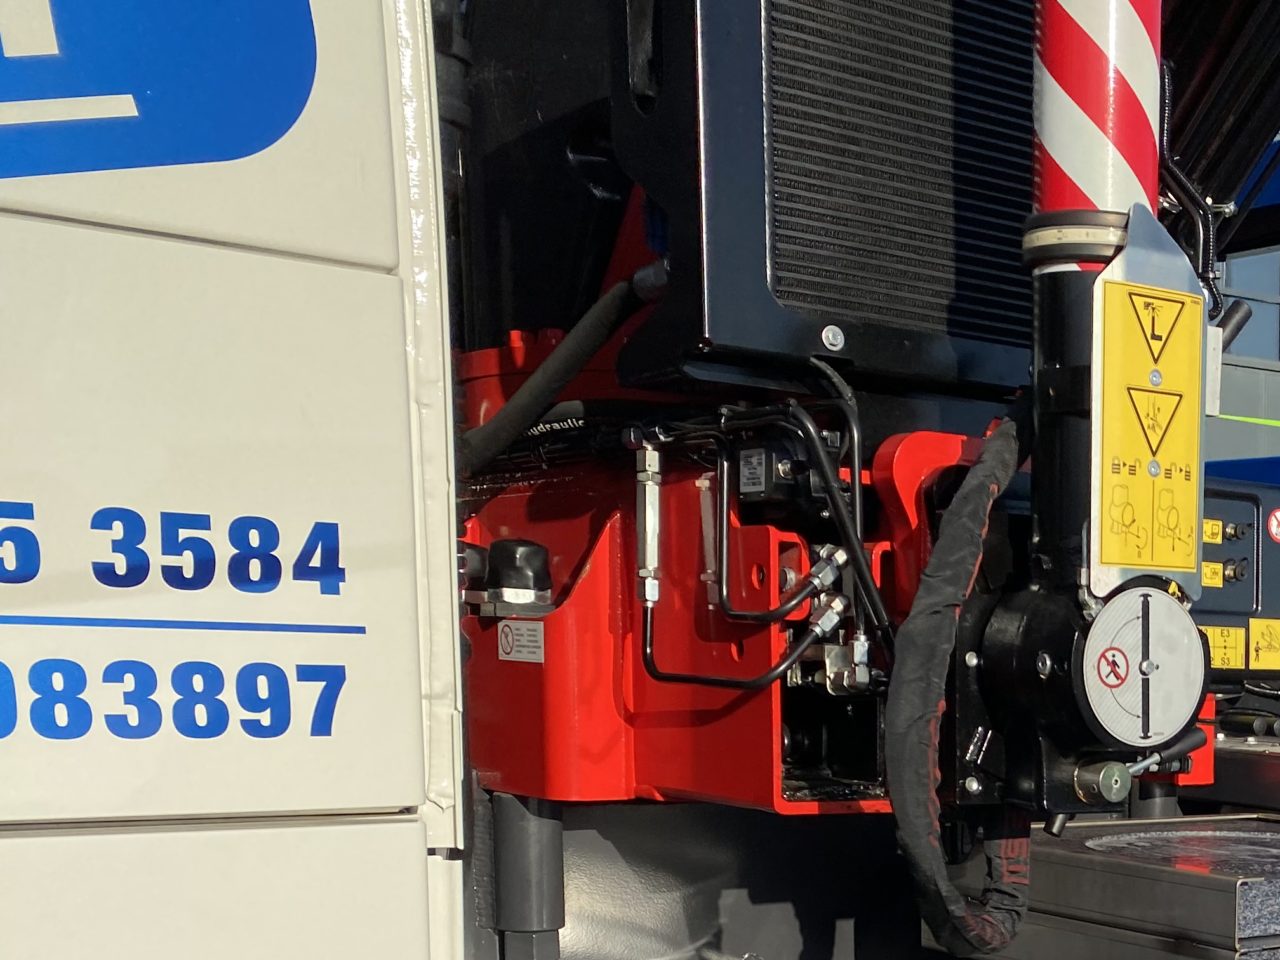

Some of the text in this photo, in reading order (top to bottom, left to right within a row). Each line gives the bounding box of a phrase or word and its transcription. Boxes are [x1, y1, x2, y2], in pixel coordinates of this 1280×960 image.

[89, 506, 347, 596] 3584
[1220, 627, 1231, 638] E3
[1220, 656, 1231, 667] S3
[0, 658, 348, 740] 83897
